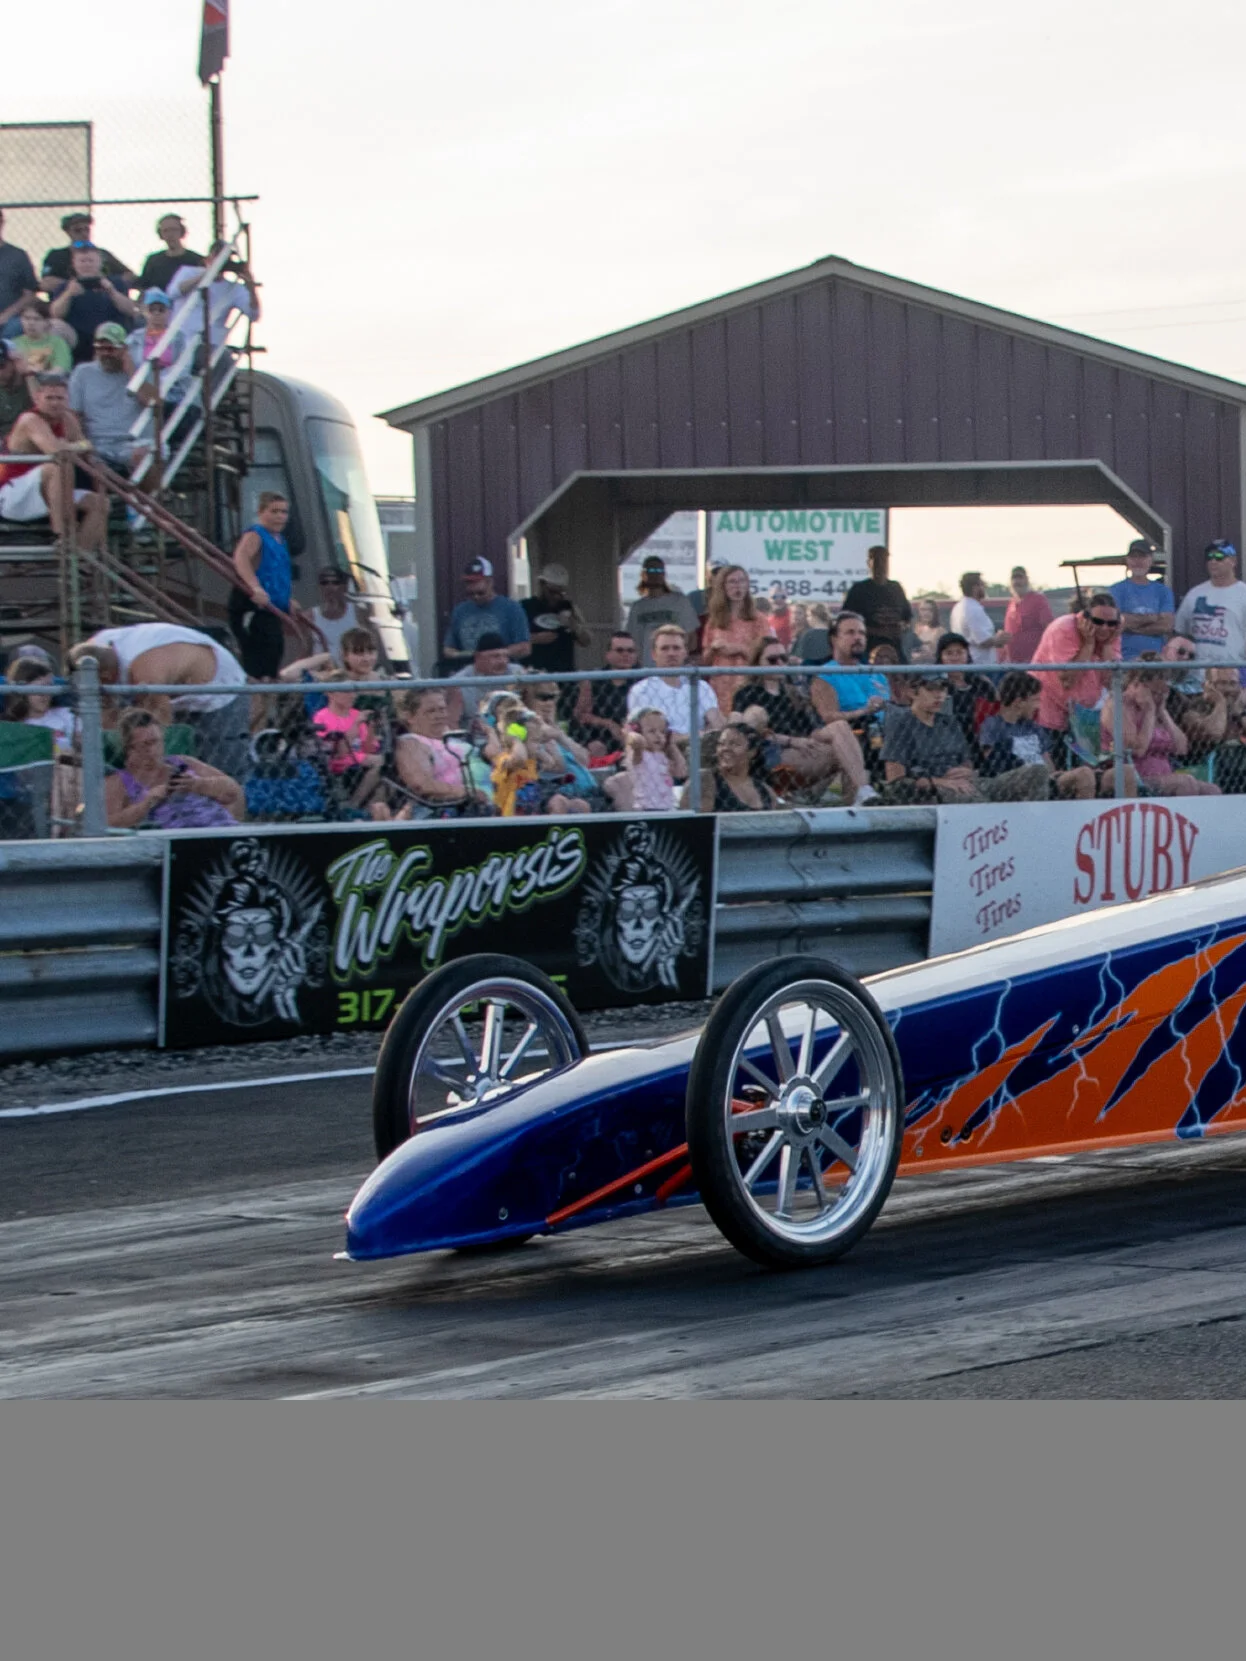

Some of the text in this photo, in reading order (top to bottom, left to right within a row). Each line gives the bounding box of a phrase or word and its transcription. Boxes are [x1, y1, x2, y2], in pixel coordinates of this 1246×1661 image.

[716, 510, 881, 533] AUTOMOTIVE
[763, 539, 834, 561] WEST
[963, 819, 1009, 860] Tires
[1073, 803, 1199, 904] STUBY
[326, 838, 397, 899] The
[969, 856, 1015, 897] Tires
[976, 892, 1022, 934] Tires
